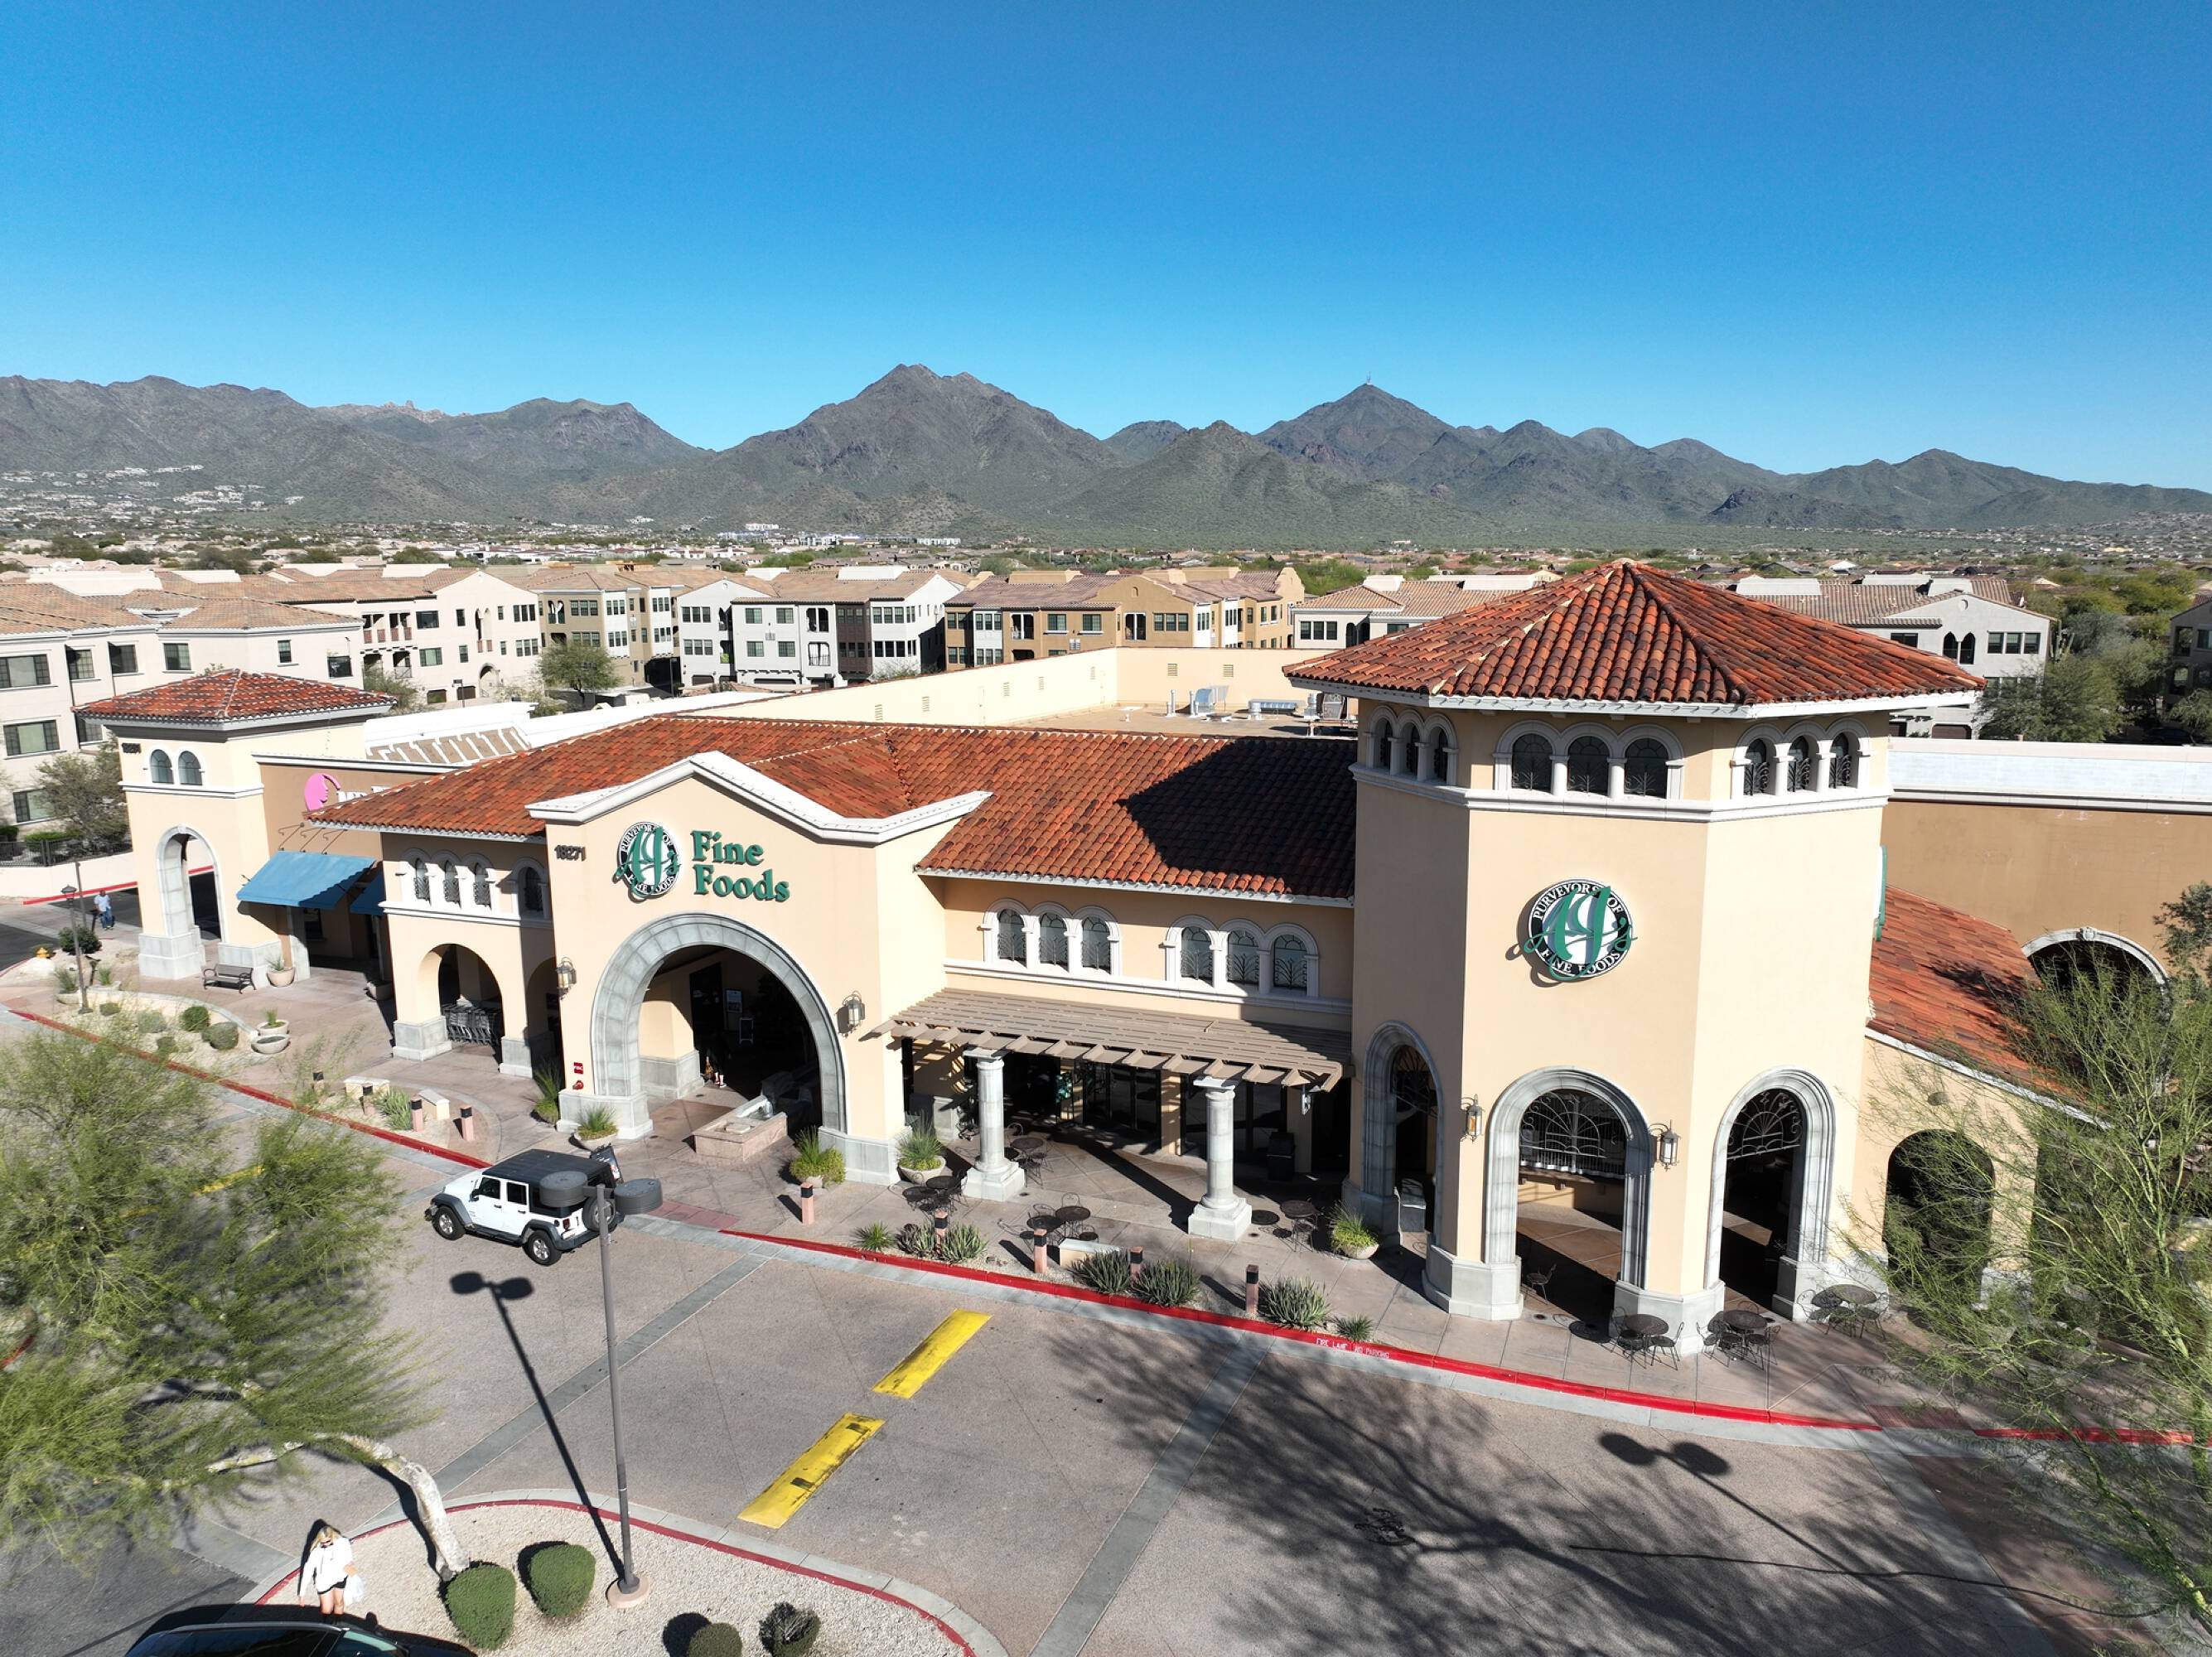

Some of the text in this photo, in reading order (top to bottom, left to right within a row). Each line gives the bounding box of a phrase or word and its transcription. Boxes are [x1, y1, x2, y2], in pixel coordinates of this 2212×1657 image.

[553, 844, 587, 862] 18271
[690, 829, 765, 867] Fine
[692, 863, 791, 903] Foods
[1606, 896, 1625, 915] OF
